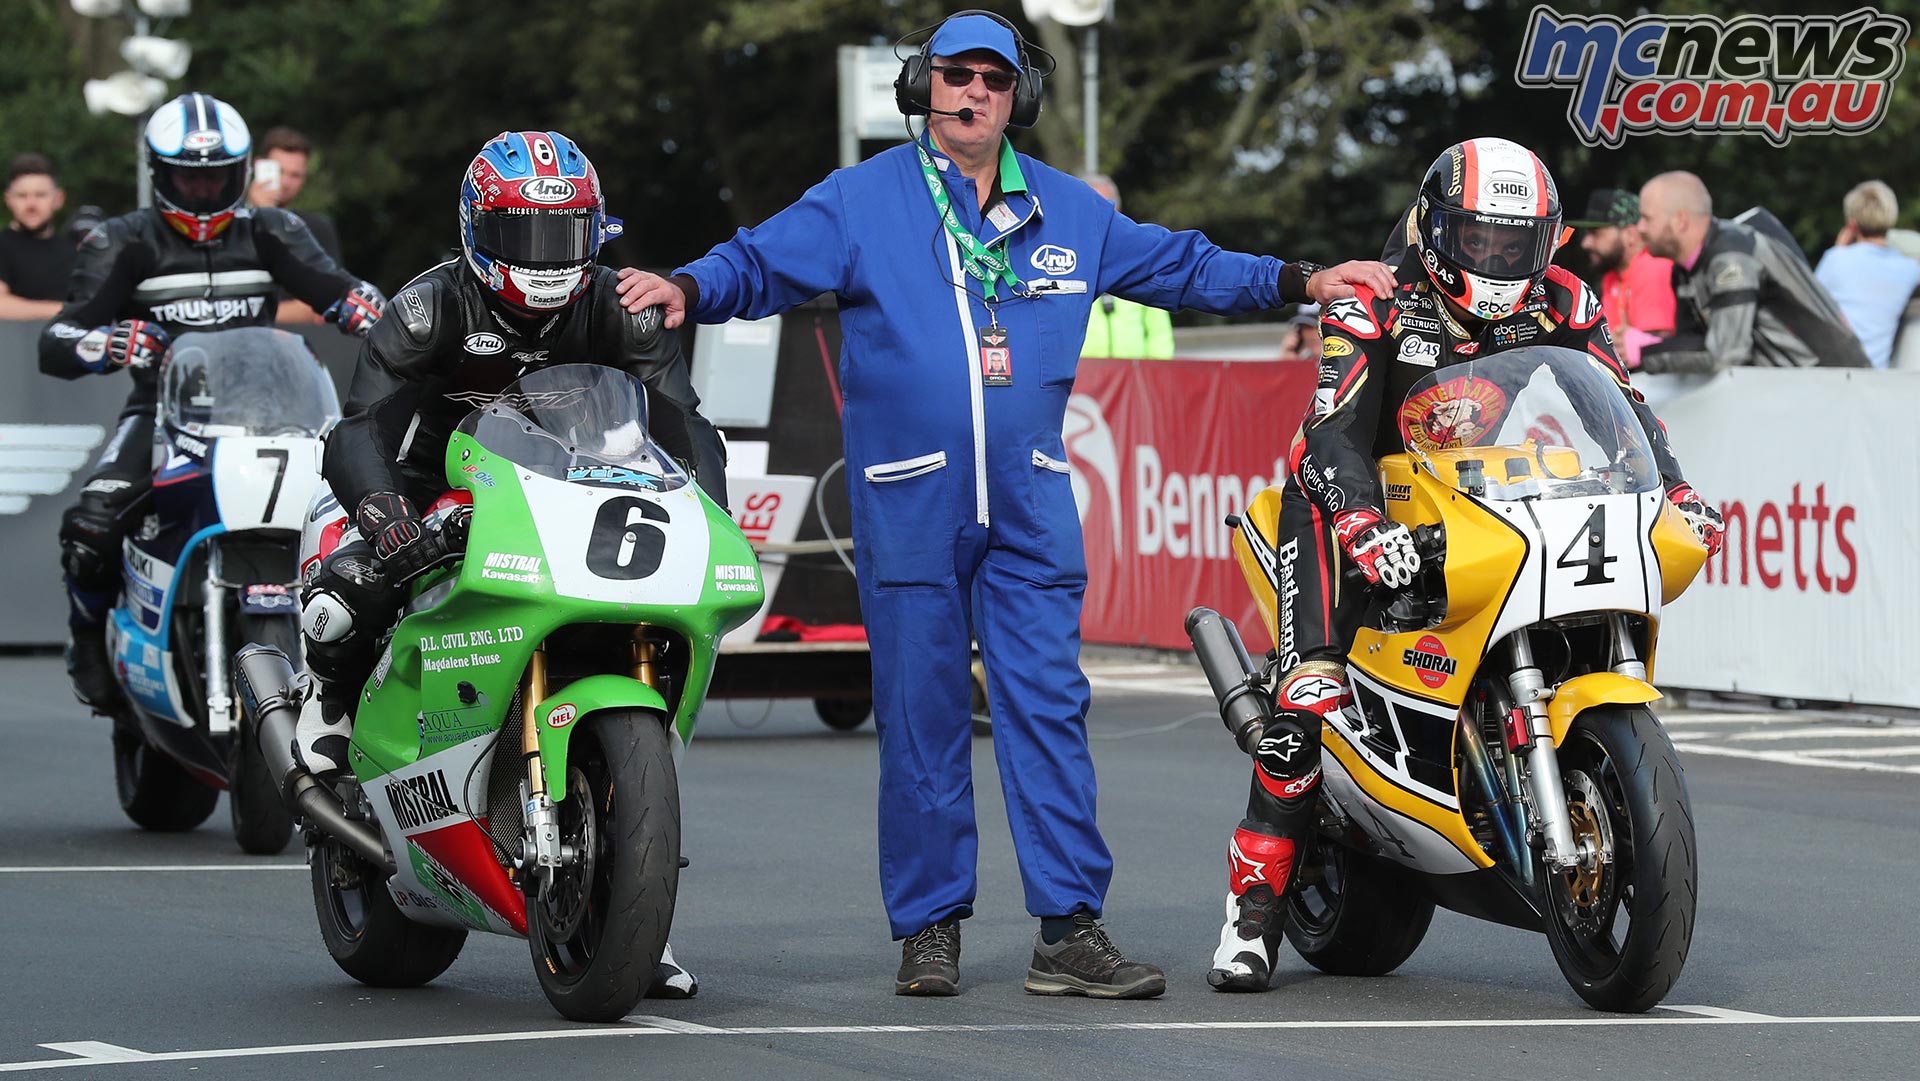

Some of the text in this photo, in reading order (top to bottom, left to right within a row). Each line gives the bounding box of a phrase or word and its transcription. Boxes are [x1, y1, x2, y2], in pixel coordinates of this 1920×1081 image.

[533, 180, 569, 195] Arai
[1492, 183, 1528, 197] SHOEI
[507, 207, 588, 216] SECRETS NIGHTCLUB
[1475, 214, 1526, 226] METZELER
[1036, 246, 1077, 267] Arai
[150, 298, 250, 326] TRIUMPH
[1394, 297, 1434, 311] Aspire-Ho
[1477, 299, 1510, 313] ebc
[1401, 317, 1440, 331] KELTRUCK
[1493, 323, 1517, 336] ebc
[467, 336, 500, 348] Arai
[256, 449, 289, 523] 7
[1301, 454, 1345, 512] Aspire-Ho
[586, 496, 670, 580] 6
[1557, 503, 1617, 587] 4
[484, 552, 542, 573] MISTRAL
[715, 564, 756, 581] MISTRAL
[715, 581, 759, 593] Kawasaki
[1280, 536, 1301, 673] Bathams
[420, 626, 524, 652] D.L. CIVIL ENG. LTD
[423, 653, 501, 672] Magdalene House
[1402, 649, 1457, 676] SHORAI
[552, 712, 573, 725] HEL
[385, 769, 461, 830] MISTRAL
